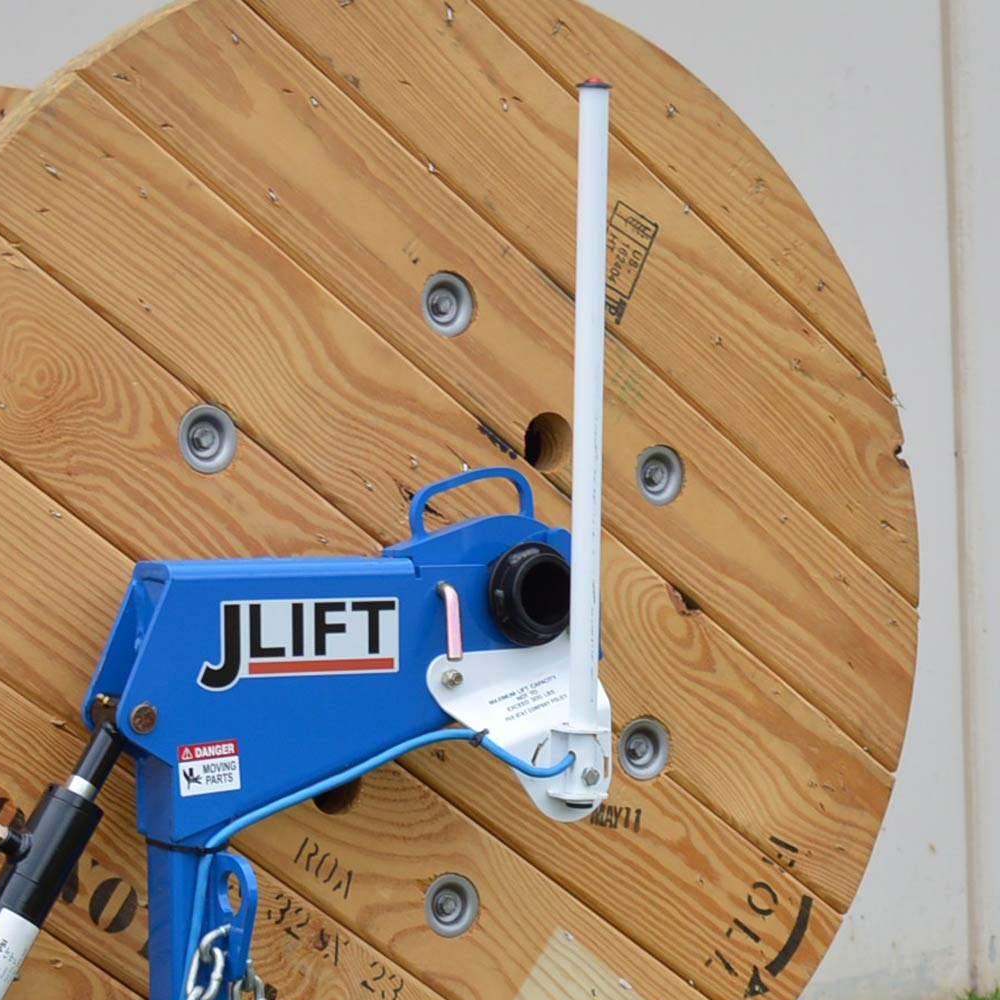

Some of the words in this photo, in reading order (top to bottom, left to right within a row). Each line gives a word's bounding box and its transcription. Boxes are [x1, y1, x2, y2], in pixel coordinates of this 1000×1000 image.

[488, 691, 516, 705] MAXIMUM
[194, 743, 235, 759] DANGER
[203, 760, 236, 774] MOVING
[205, 772, 234, 785] PARTS
